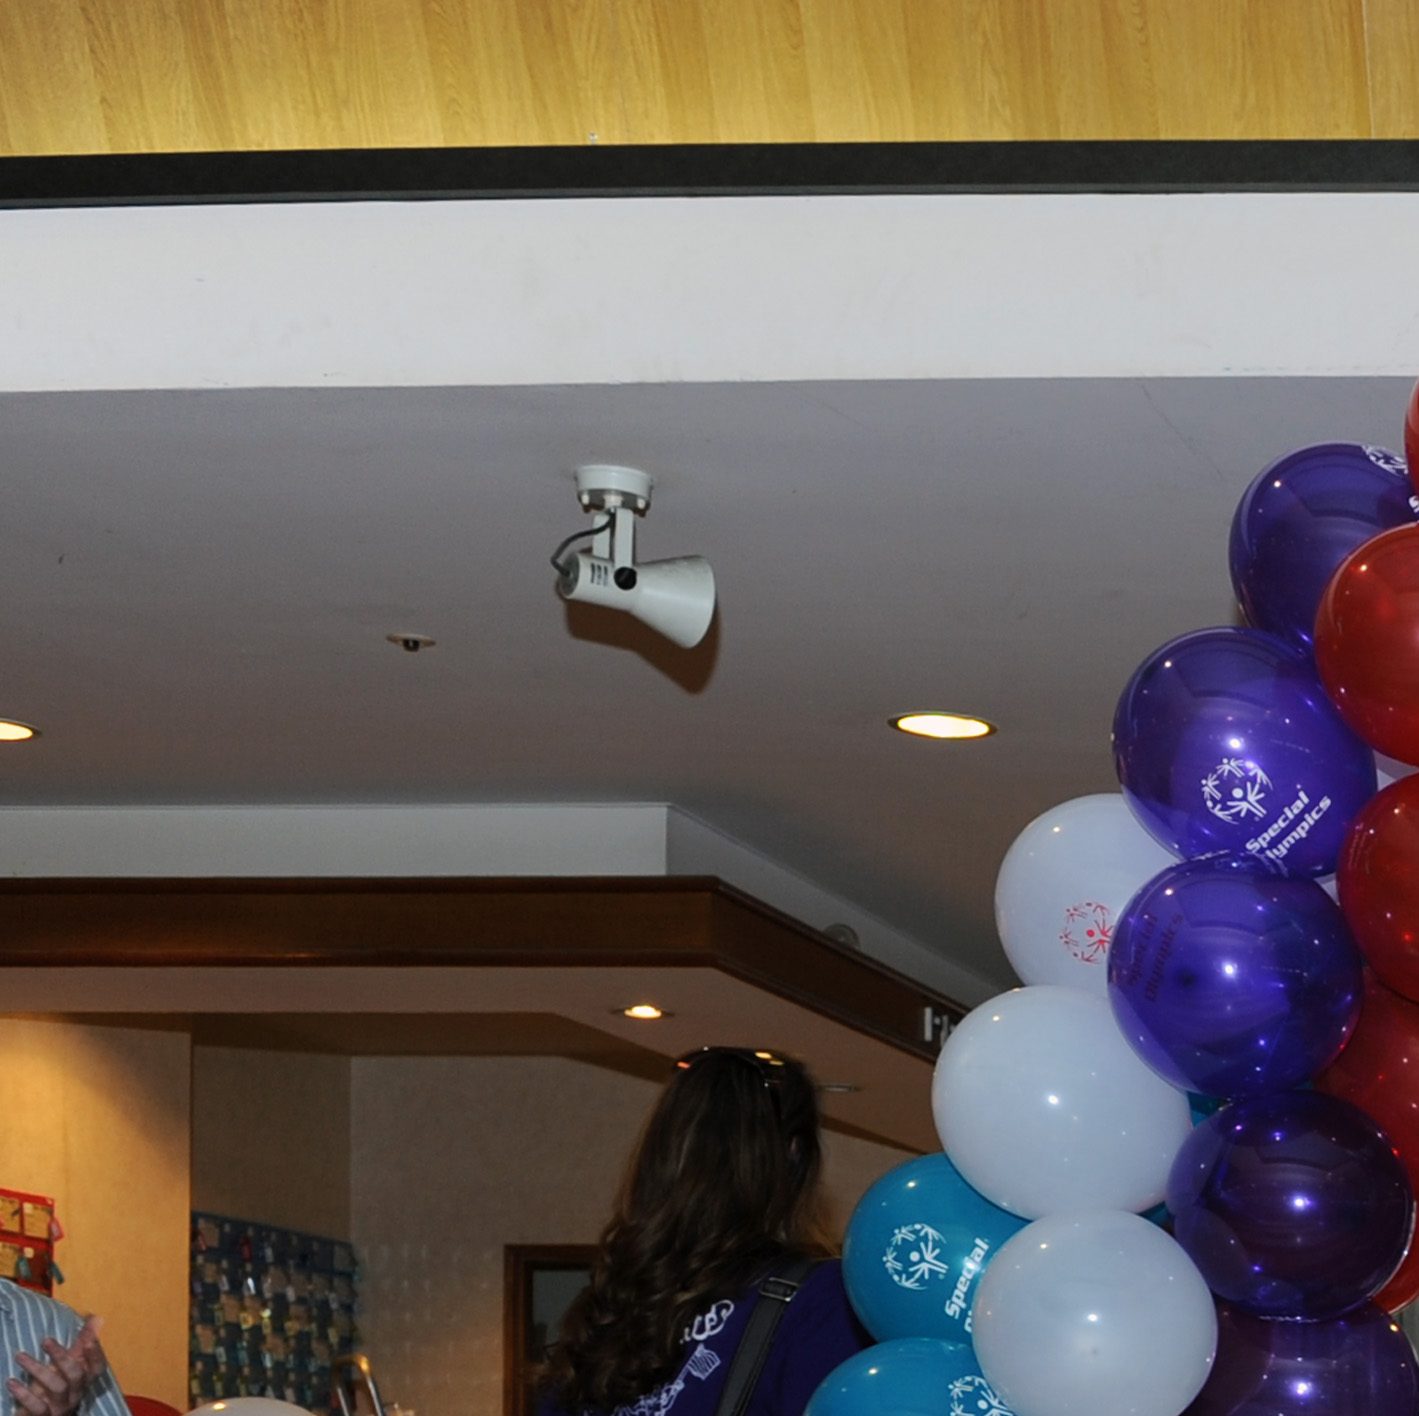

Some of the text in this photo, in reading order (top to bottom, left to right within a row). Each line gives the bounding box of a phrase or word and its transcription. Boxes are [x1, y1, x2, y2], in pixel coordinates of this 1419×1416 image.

[1245, 790, 1310, 854] Special
[1265, 795, 1332, 859] lympics
[945, 1237, 989, 1320] Special
